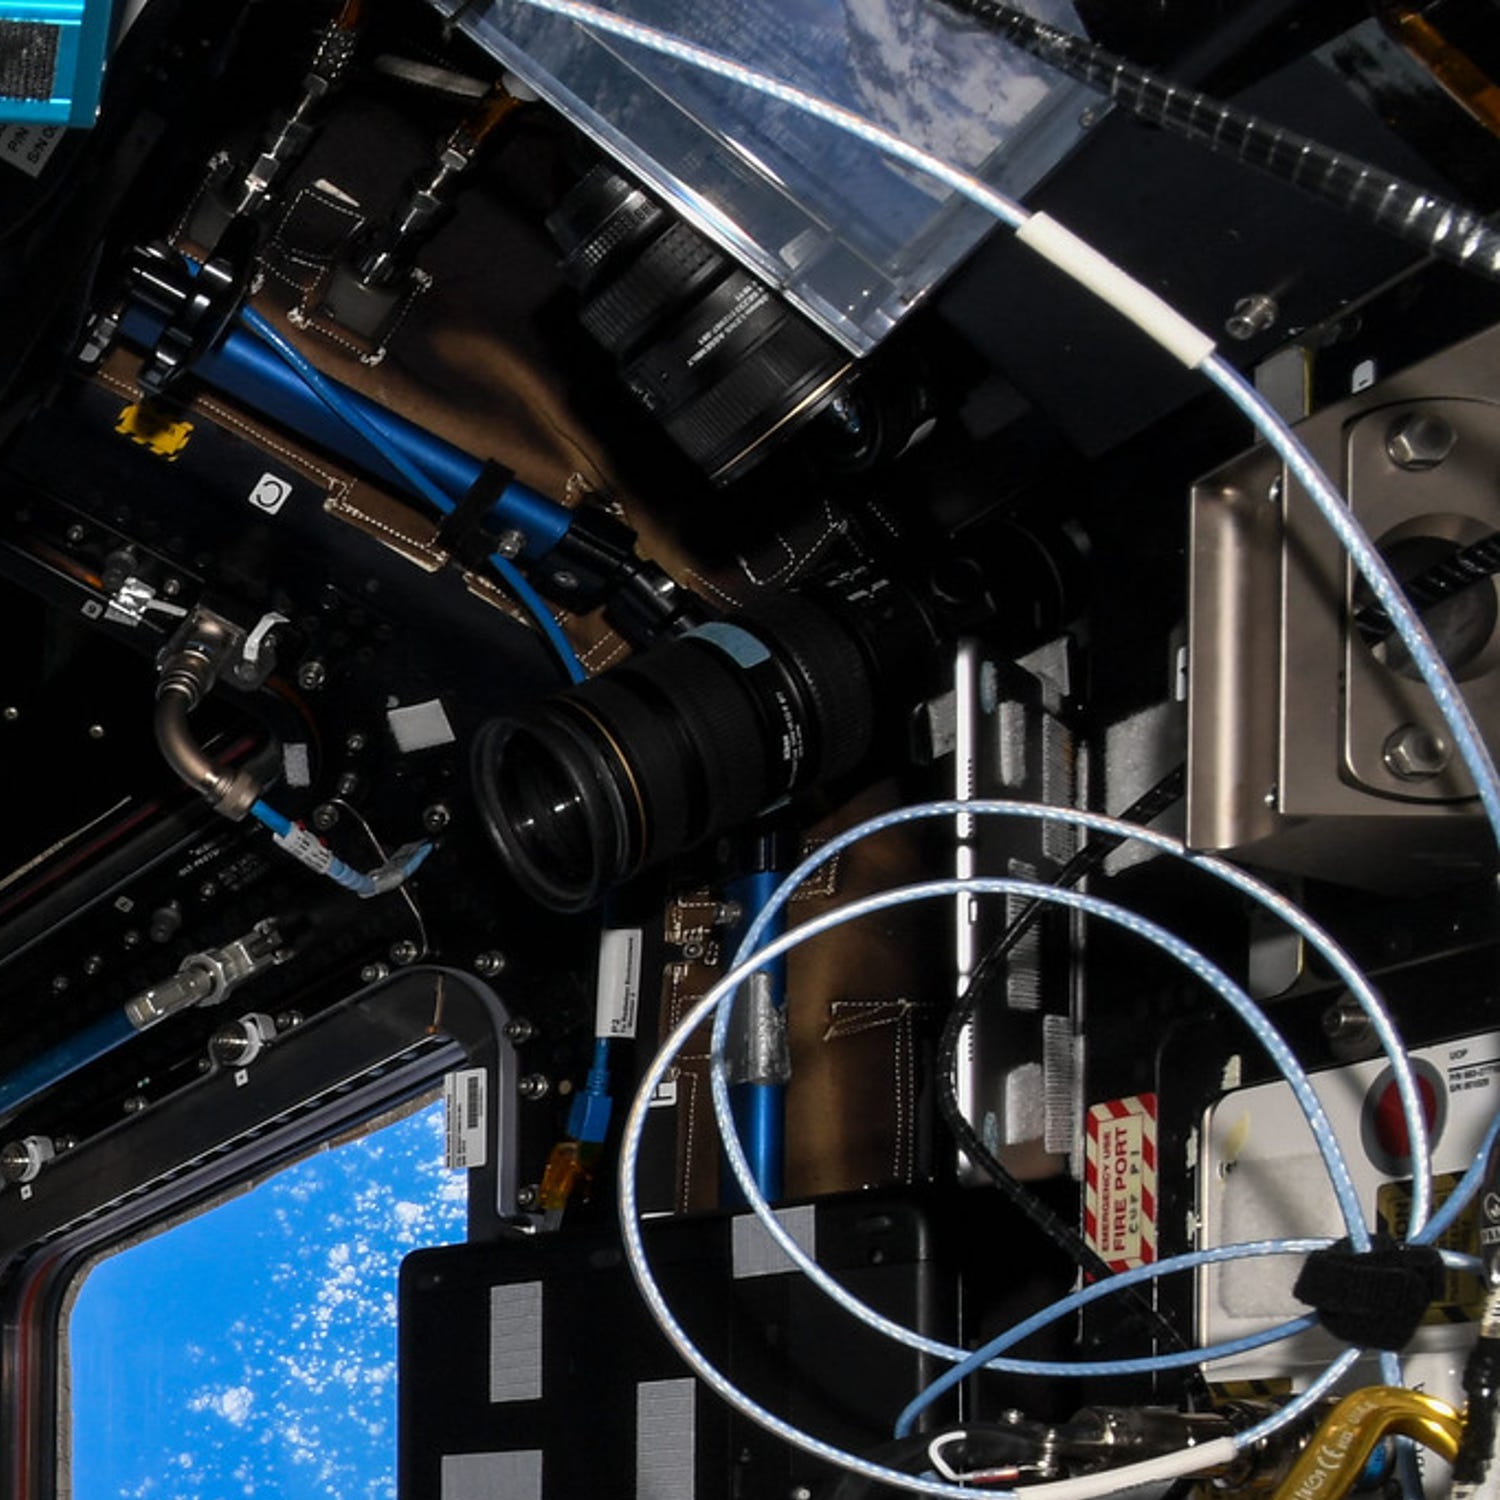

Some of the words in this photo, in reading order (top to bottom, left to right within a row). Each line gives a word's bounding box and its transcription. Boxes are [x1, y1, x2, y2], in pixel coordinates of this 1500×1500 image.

[1103, 1130, 1112, 1159] USE
[1114, 1127, 1128, 1191] PORT
[1101, 1164, 1110, 1252] EMERGENCY
[1114, 1199, 1127, 1251] FIRE
